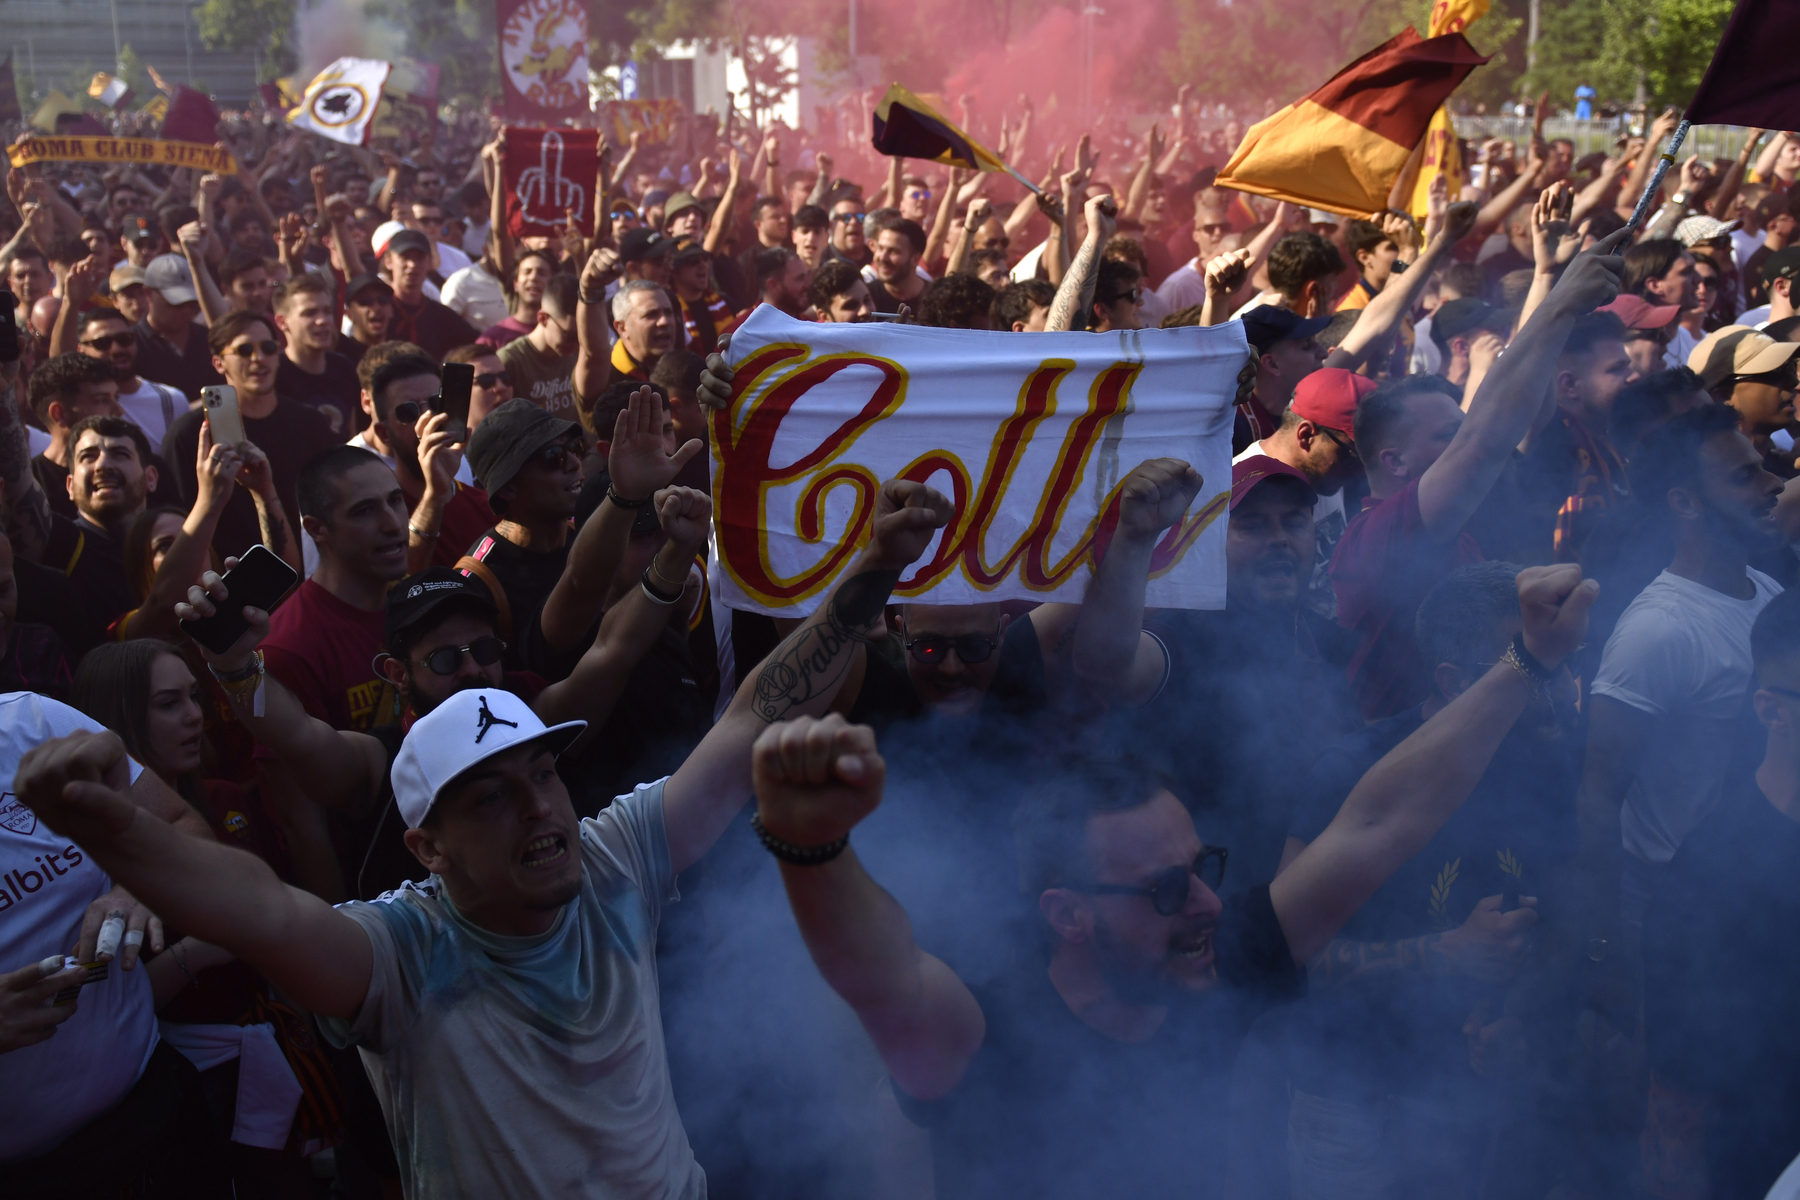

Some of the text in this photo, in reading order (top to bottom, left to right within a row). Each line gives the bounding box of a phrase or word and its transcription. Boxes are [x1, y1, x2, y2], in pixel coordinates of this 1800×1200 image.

[19, 139, 229, 170] ROMA CLUB SIENA
[8, 812, 34, 831] ROMA
